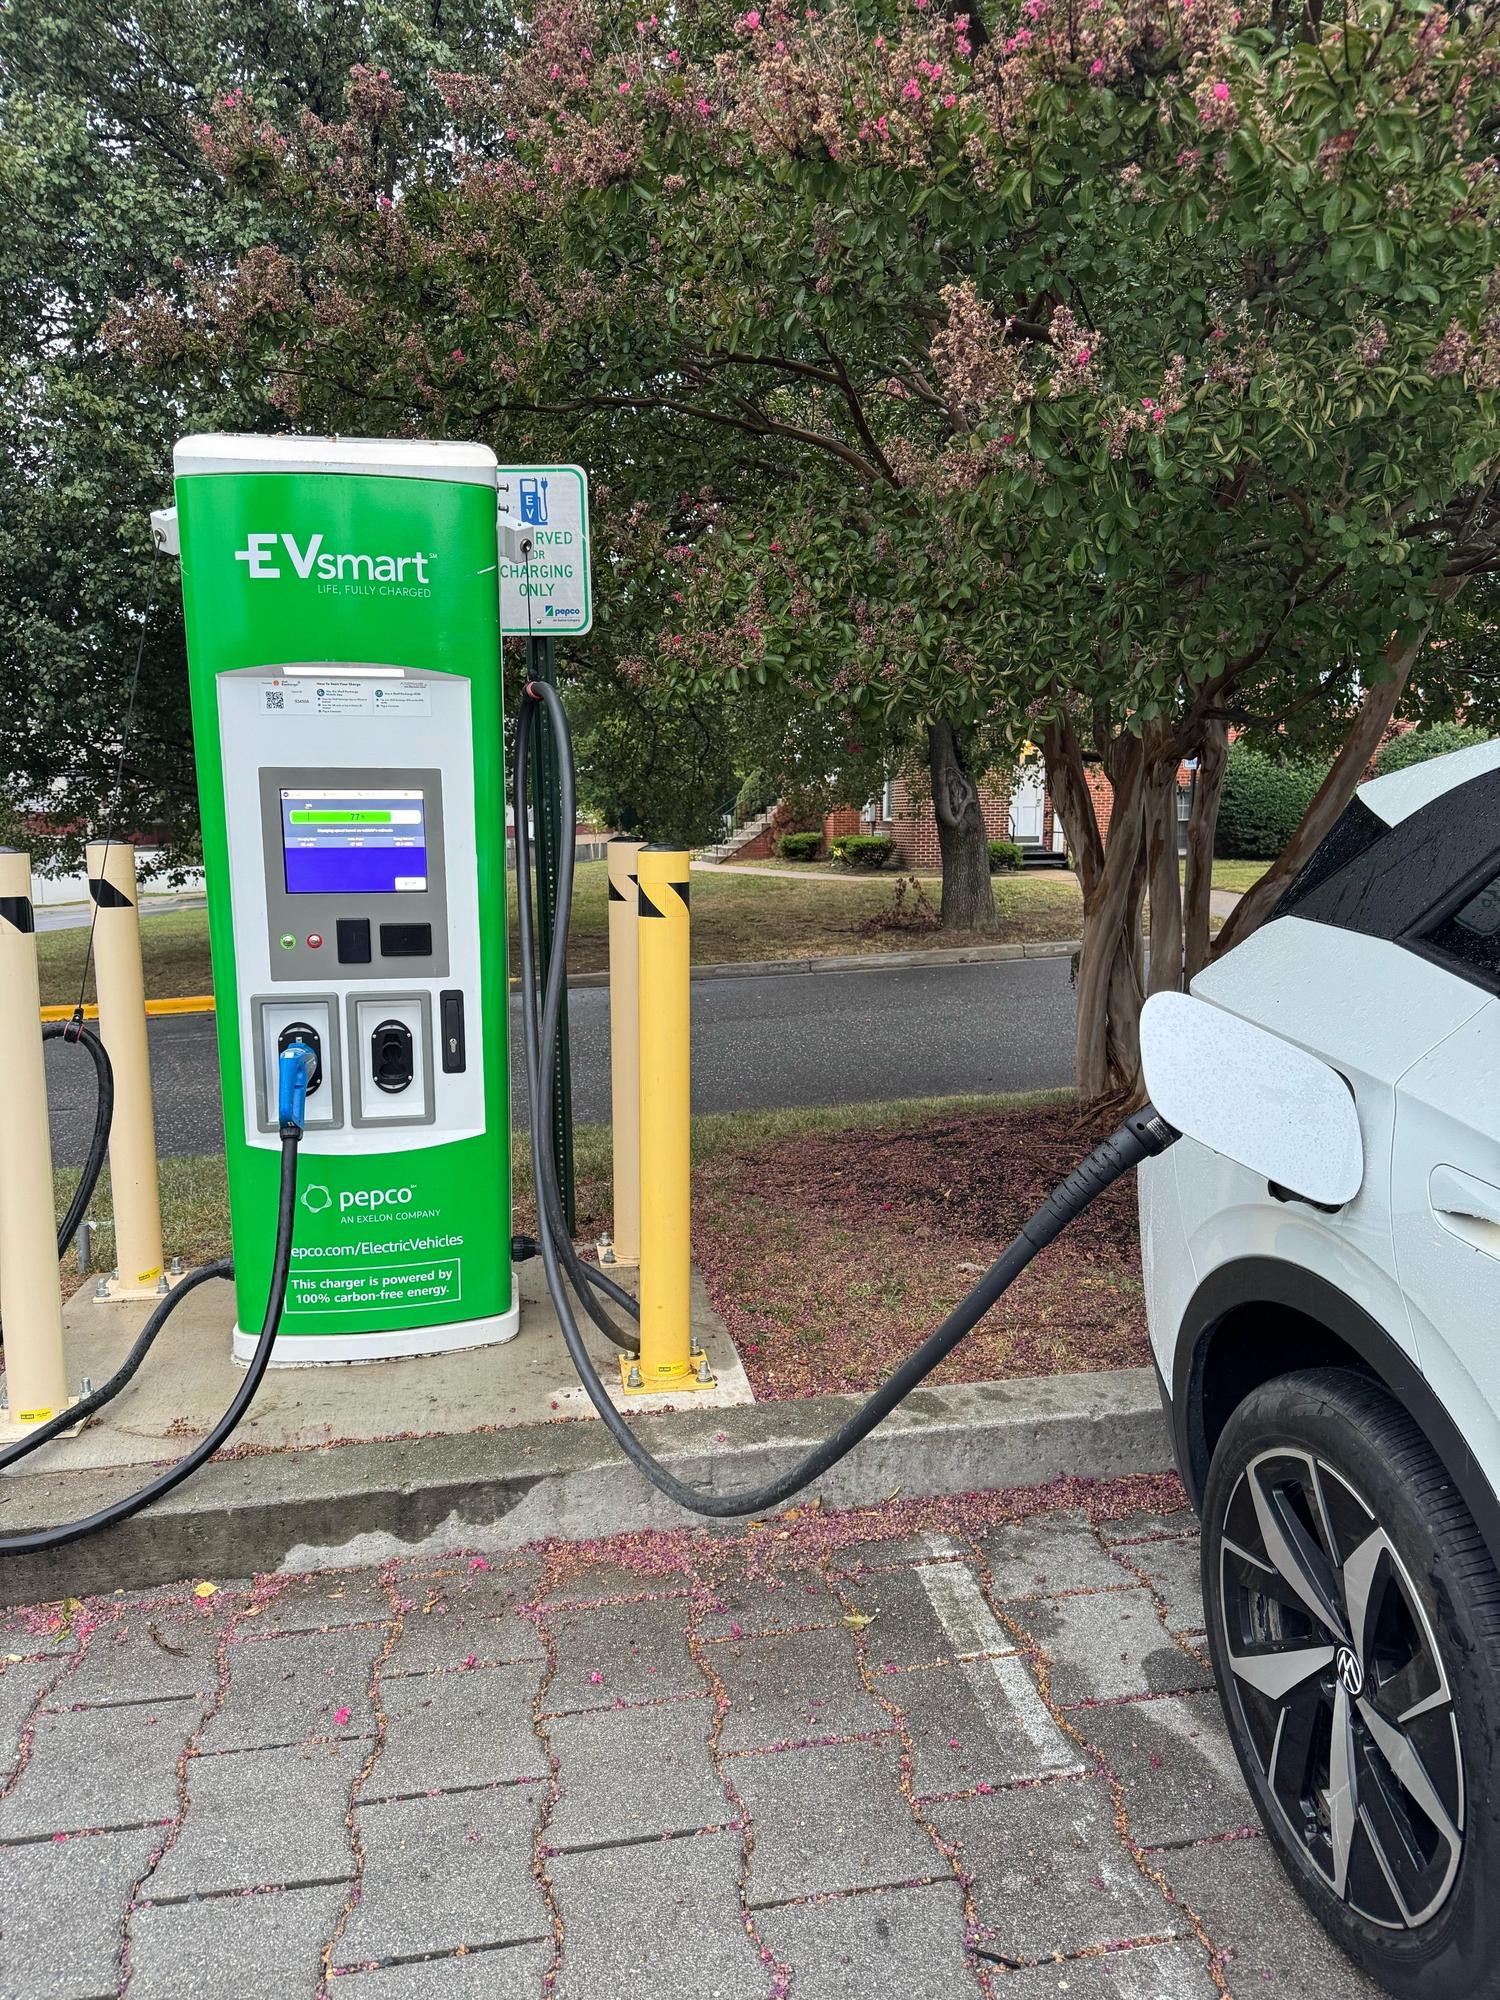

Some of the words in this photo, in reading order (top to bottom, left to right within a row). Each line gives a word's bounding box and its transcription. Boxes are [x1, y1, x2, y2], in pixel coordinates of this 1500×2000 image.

[234, 533, 429, 584] EVsmart
[533, 550, 545, 559] OR
[501, 565, 573, 578] CHARGING
[317, 584, 342, 595] LIFE,
[345, 585, 376, 596] FULLY
[379, 586, 431, 598] CHARGED
[519, 584, 555, 597] ONLY
[554, 606, 580, 617] pepco
[339, 1187, 412, 1212] pepco
[340, 1216, 354, 1224] AN
[356, 1213, 393, 1223] EXELON
[395, 1209, 441, 1221] COMPANY
[291, 1234, 464, 1260] epco.com/ElectricVehicles
[291, 1279, 317, 1290] This
[319, 1278, 365, 1291] charger
[369, 1276, 379, 1287] is
[382, 1270, 435, 1286] powered
[438, 1269, 453, 1281] by
[296, 1294, 331, 1305] 100%
[334, 1288, 404, 1303] carbon-free
[407, 1284, 450, 1299] energy.
